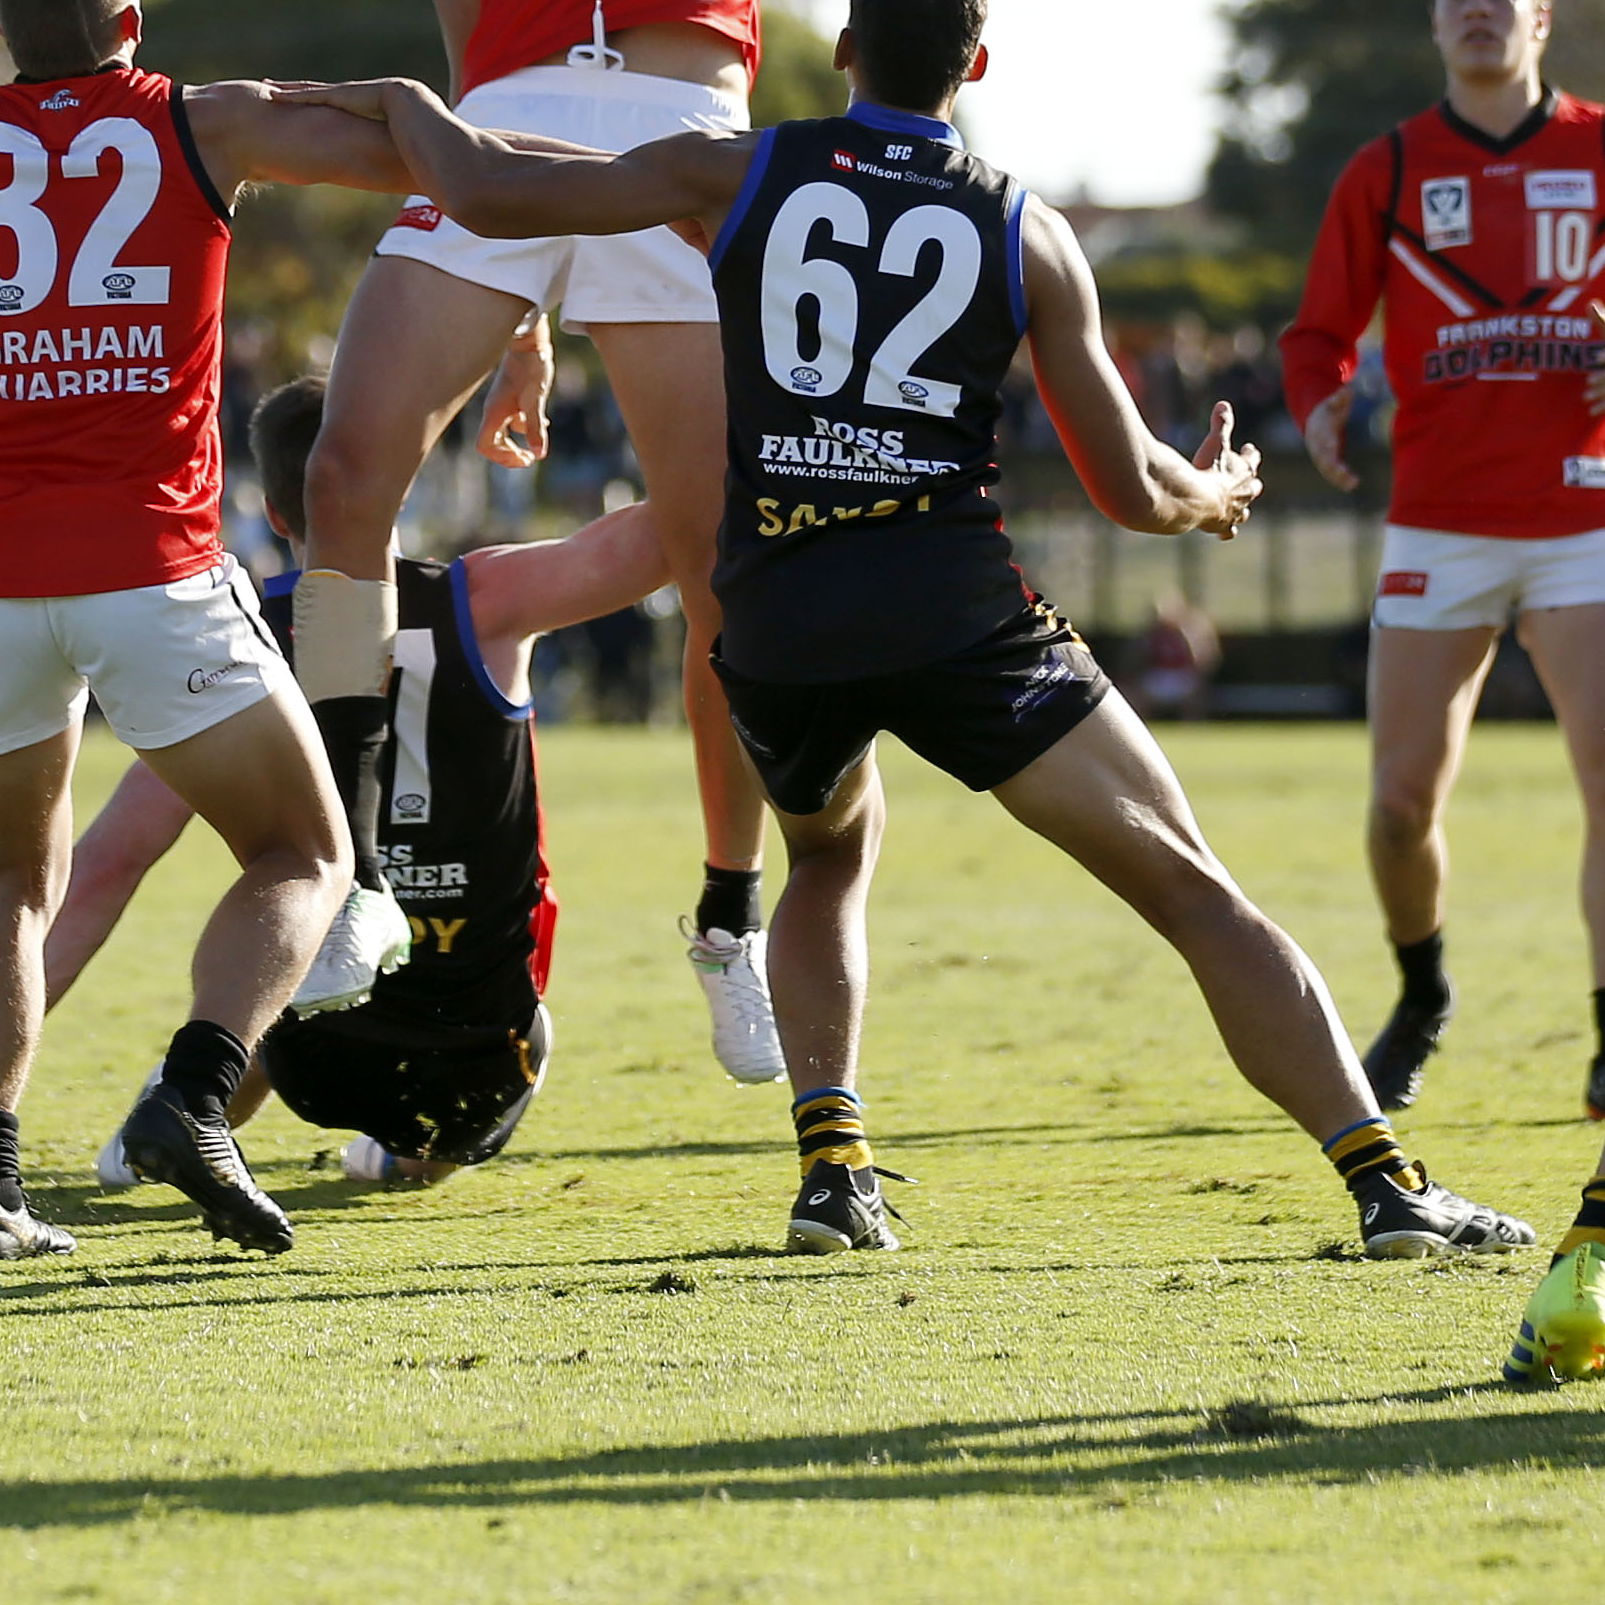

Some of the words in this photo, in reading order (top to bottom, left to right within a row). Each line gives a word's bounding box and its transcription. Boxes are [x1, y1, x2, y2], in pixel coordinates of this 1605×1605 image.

[884, 144, 912, 160] SFC
[856, 161, 902, 180] Wilson
[903, 171, 954, 190] Storage
[1536, 211, 1590, 281] 10
[761, 182, 982, 418] 62
[1437, 315, 1591, 347] FRANKSTON
[811, 415, 904, 456] ROSS
